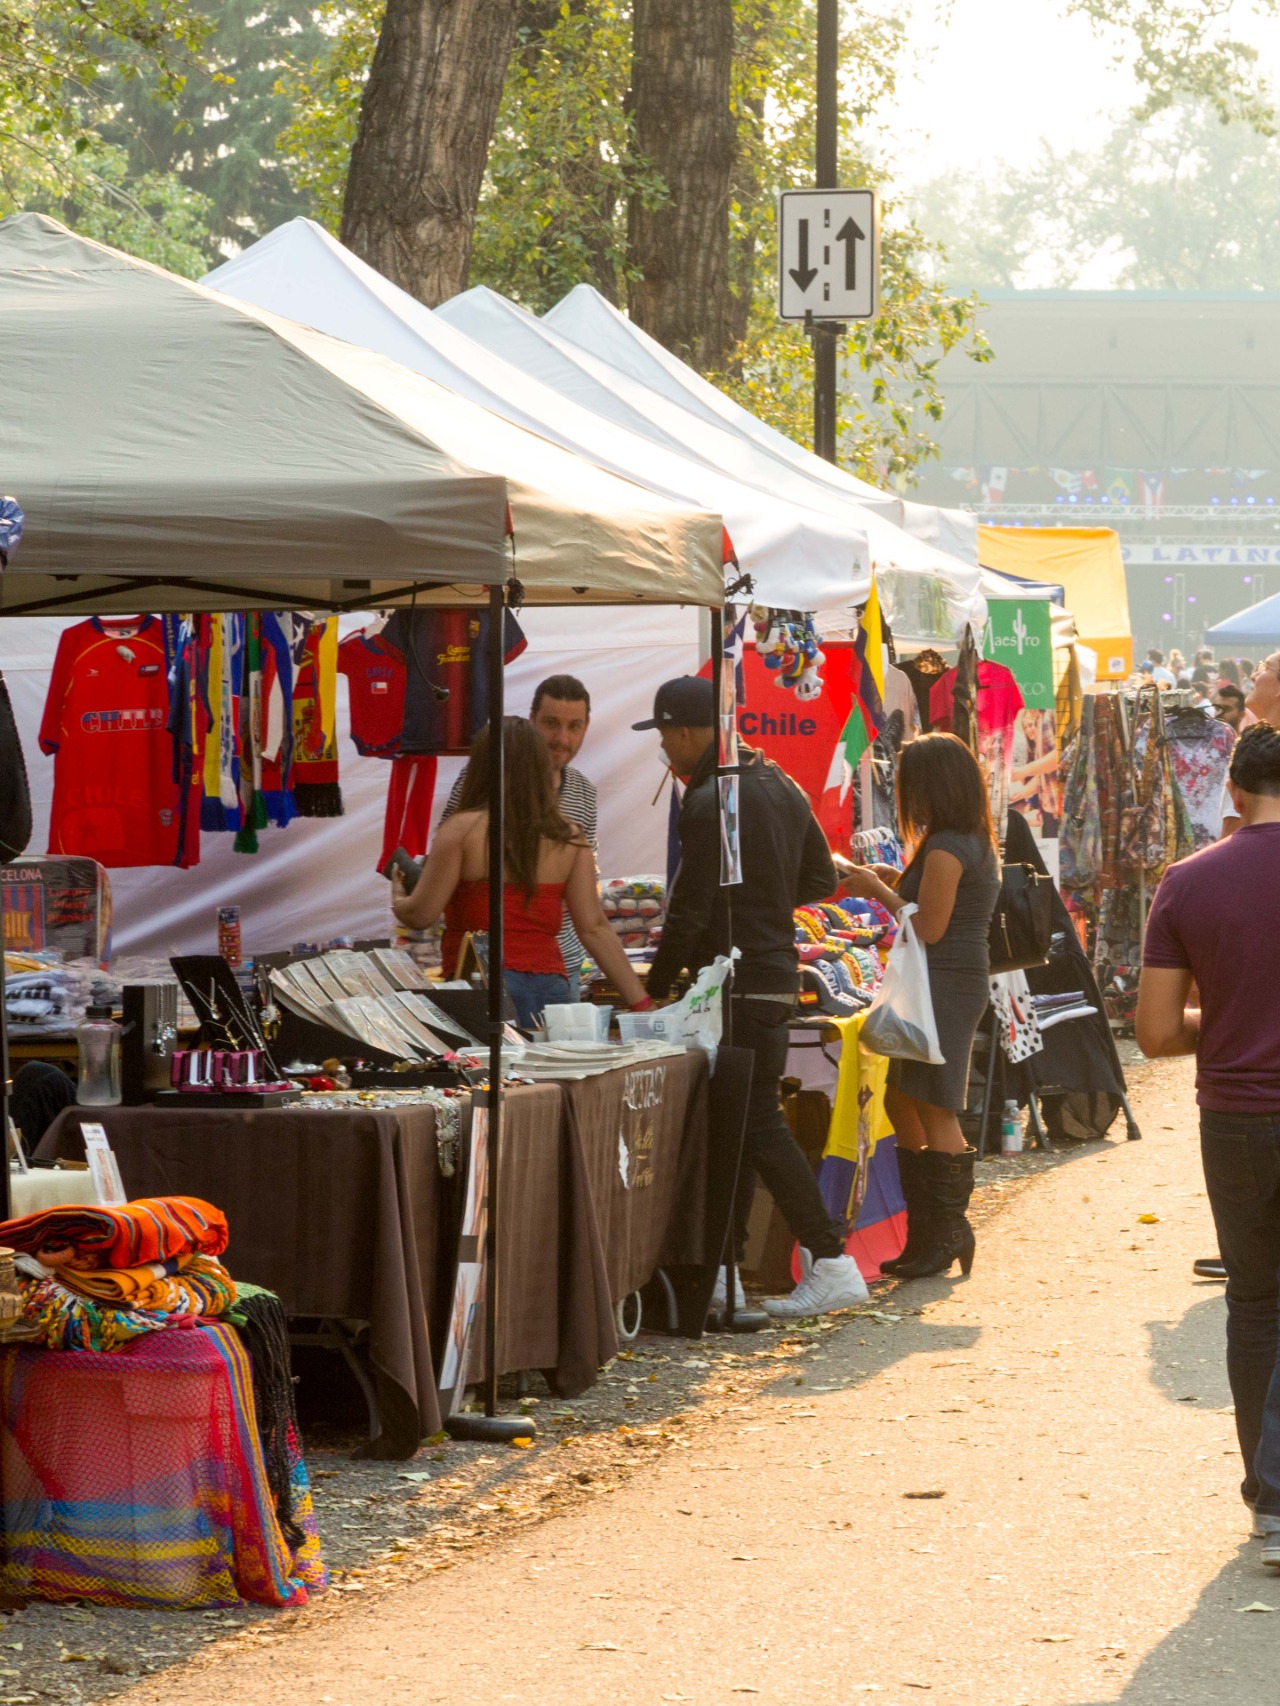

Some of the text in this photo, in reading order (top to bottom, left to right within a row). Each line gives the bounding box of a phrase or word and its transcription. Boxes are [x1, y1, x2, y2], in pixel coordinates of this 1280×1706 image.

[81, 708, 164, 733] CHILE
[739, 712, 818, 737] Chile
[0, 867, 43, 882] CELONA
